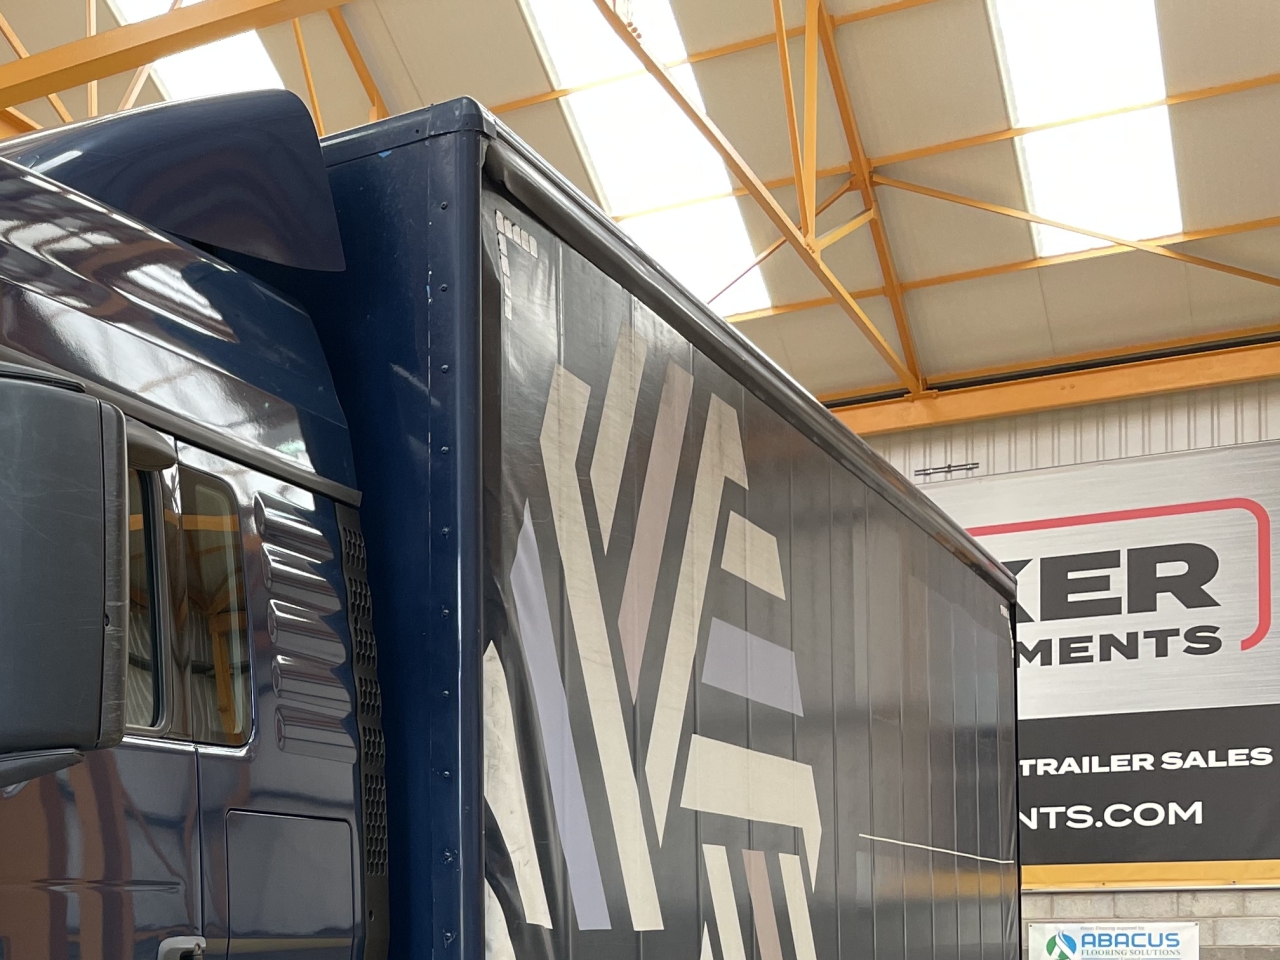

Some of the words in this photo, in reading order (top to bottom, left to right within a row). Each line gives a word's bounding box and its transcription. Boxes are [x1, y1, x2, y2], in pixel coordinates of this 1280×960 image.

[1019, 752, 1154, 777] TRAILER
[1160, 747, 1273, 771] SALES
[1081, 933, 1180, 948] ABACUS
